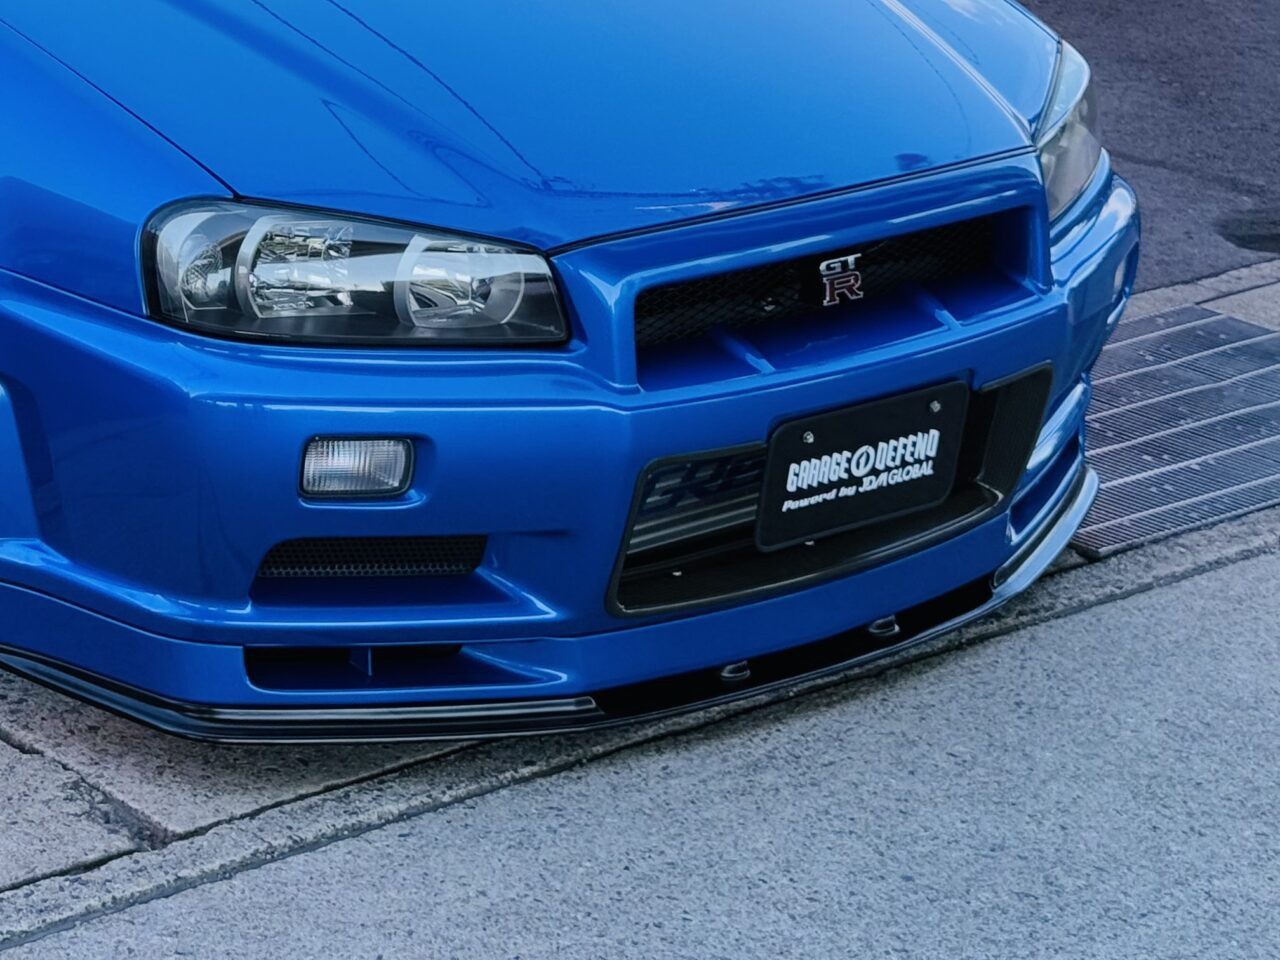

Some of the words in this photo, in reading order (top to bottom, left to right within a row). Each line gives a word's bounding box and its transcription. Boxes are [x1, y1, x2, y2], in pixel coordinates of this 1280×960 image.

[786, 449, 853, 493] GARAGE
[874, 428, 941, 471] DEFEND
[838, 485, 857, 498] by
